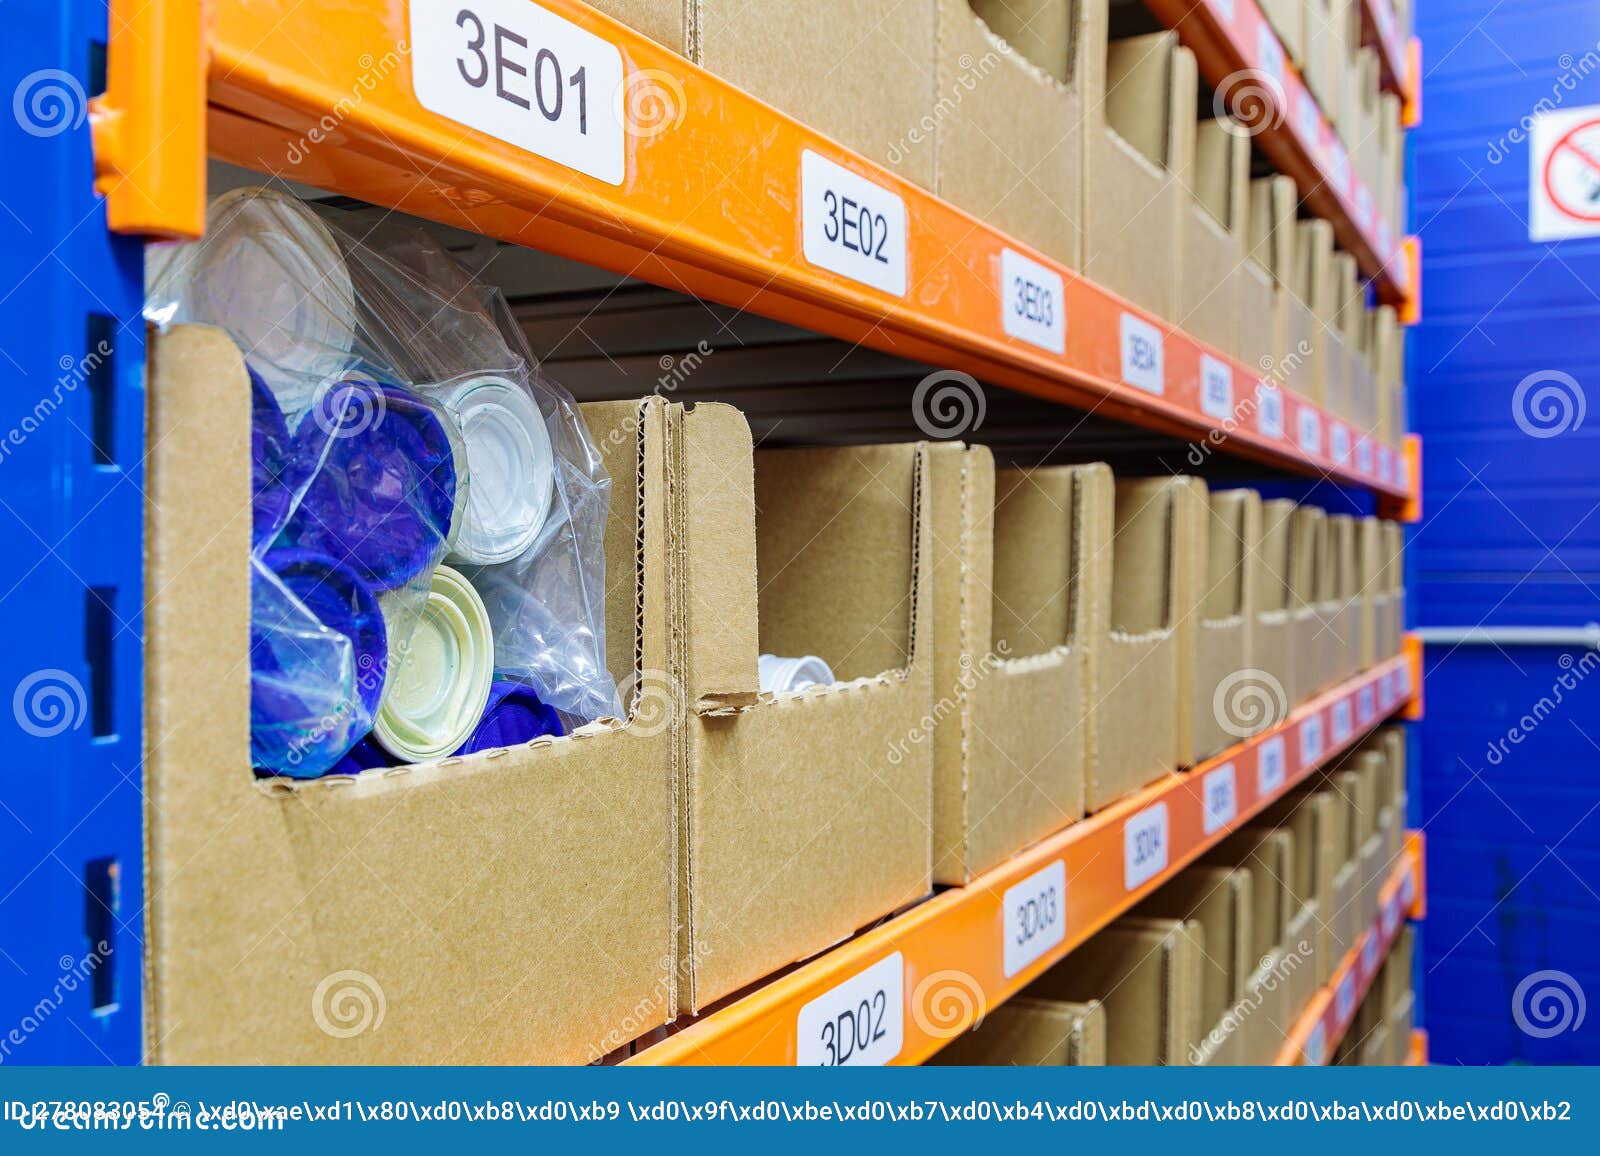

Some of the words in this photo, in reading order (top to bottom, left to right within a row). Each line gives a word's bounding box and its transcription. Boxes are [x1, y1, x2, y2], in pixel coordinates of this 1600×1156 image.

[456, 9, 588, 135] 3E01
[823, 190, 889, 265] 3E02
[1014, 276, 1054, 328] 3E03
[1016, 885, 1057, 947] 3D03
[820, 989, 887, 1066] 3D02
